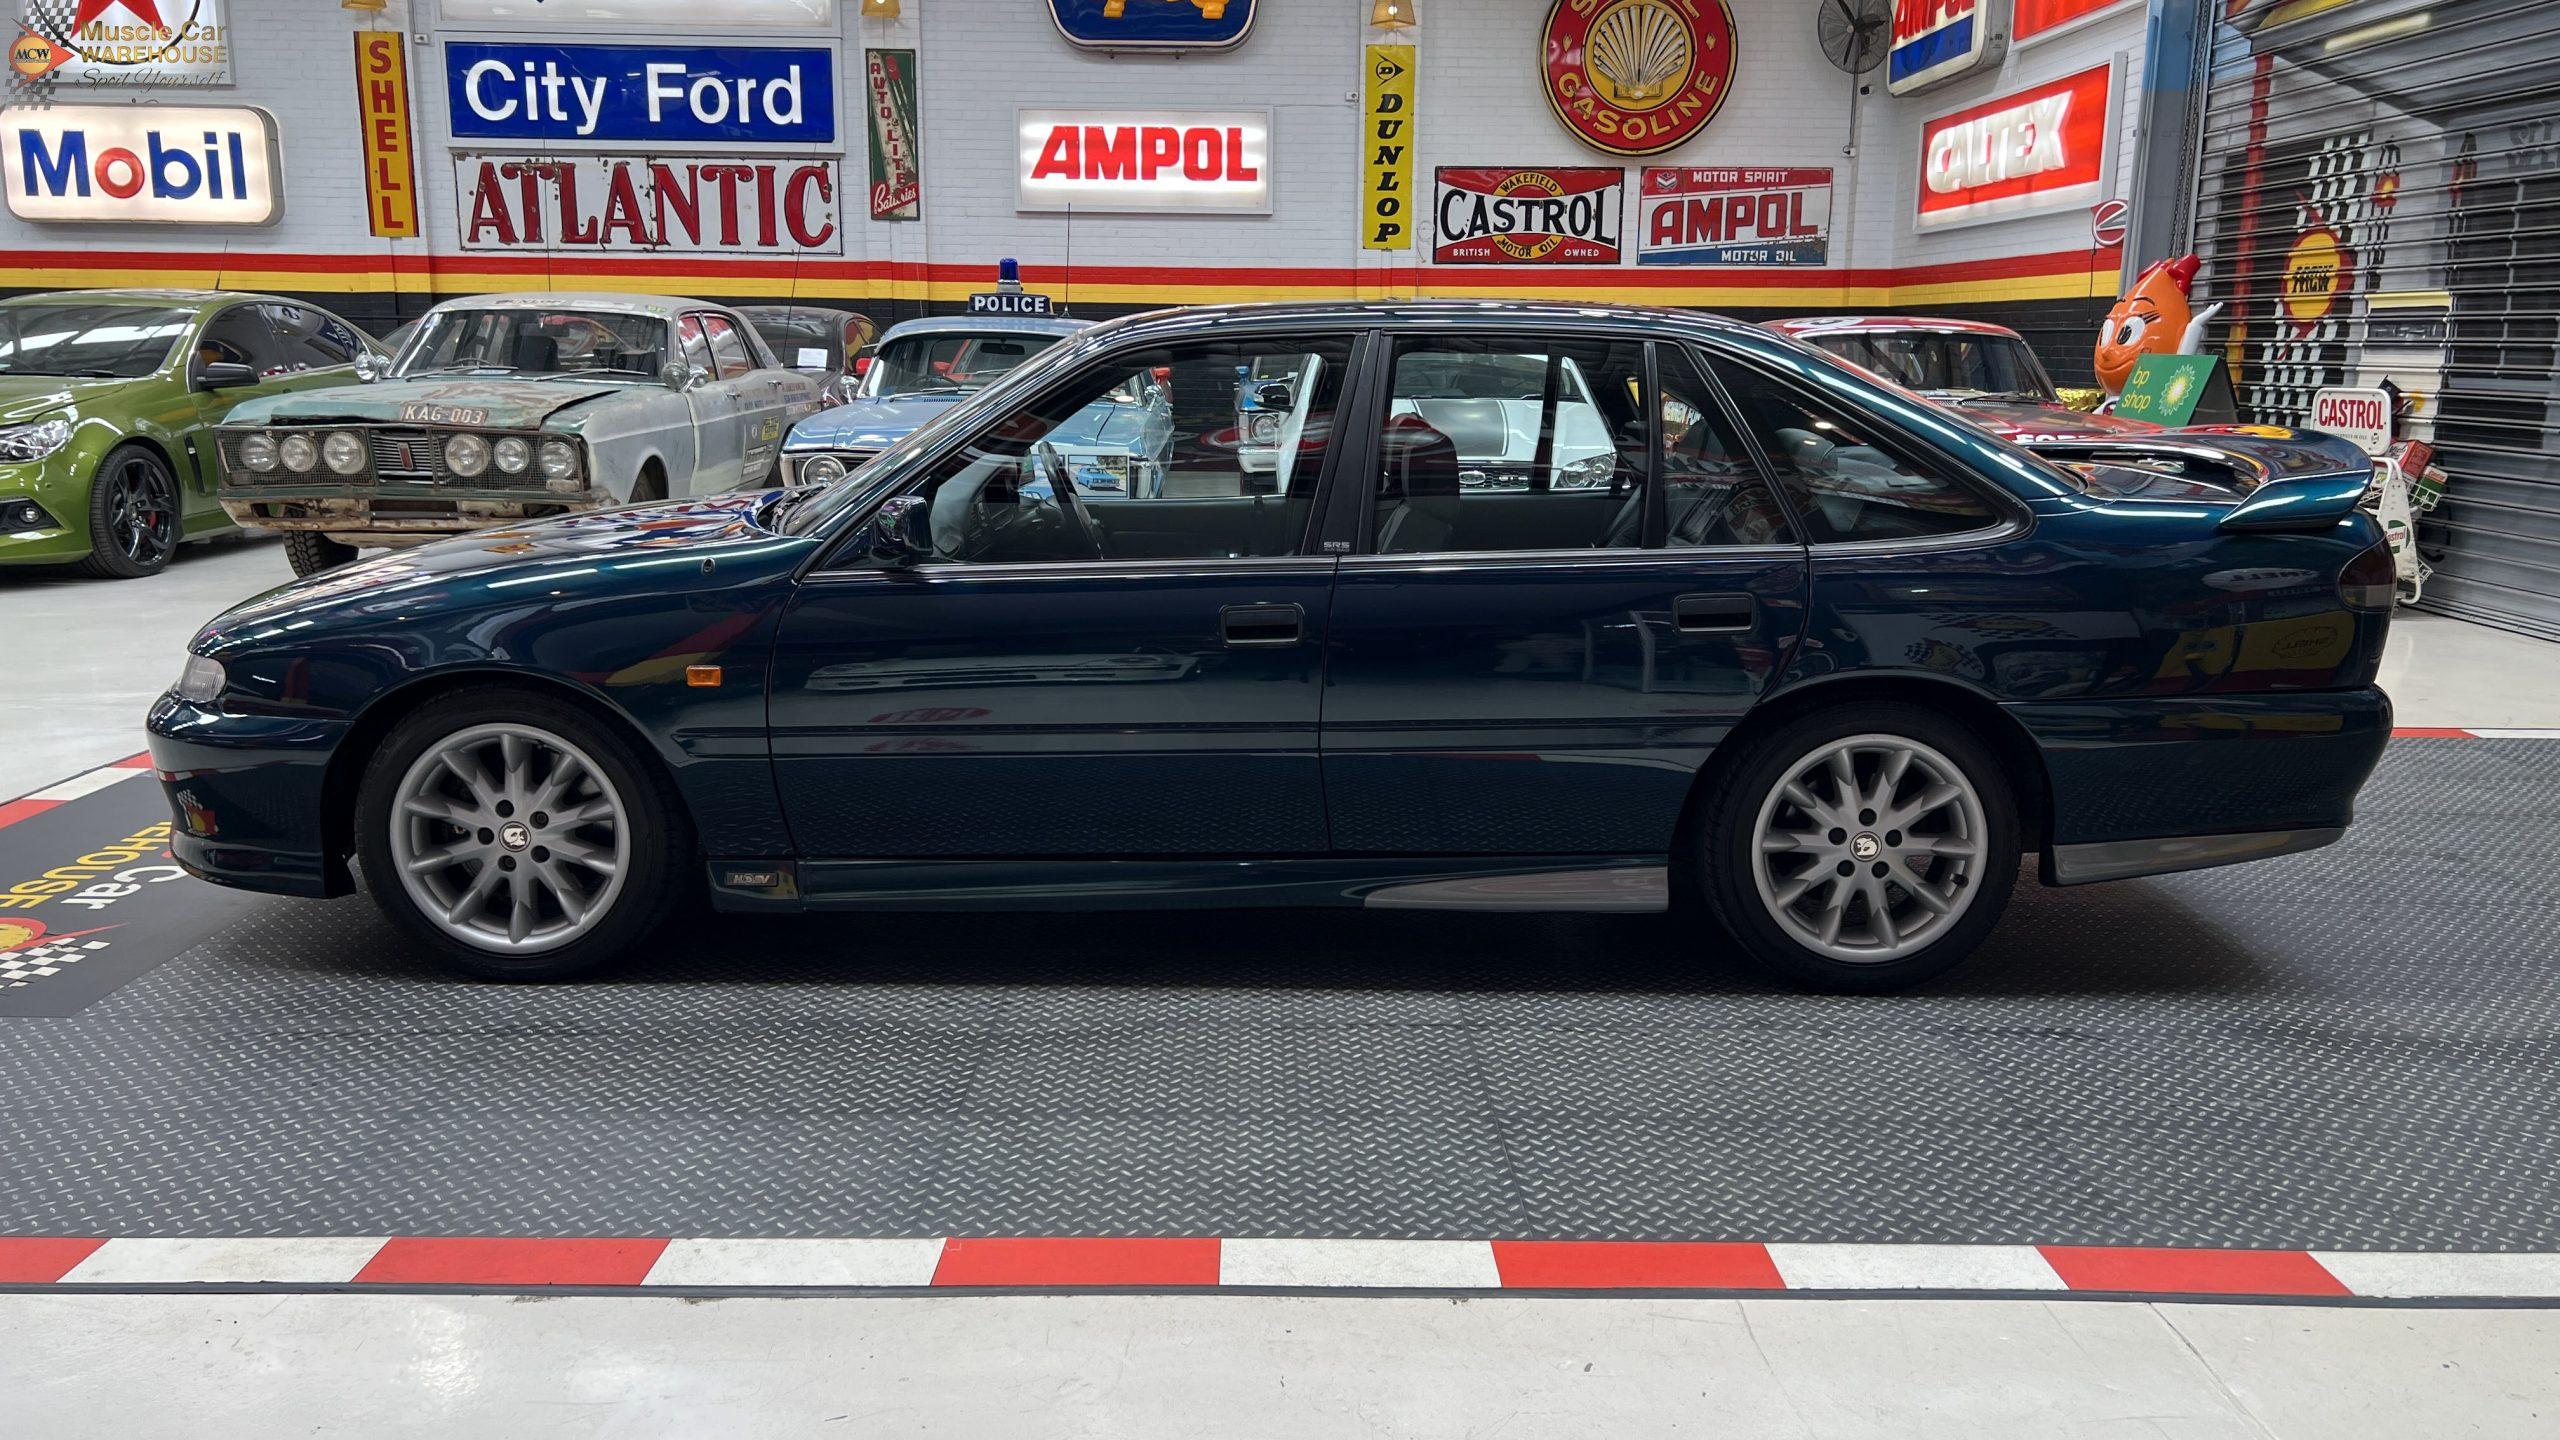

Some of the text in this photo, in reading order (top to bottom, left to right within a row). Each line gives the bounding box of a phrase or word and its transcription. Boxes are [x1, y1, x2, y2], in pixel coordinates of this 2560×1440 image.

[464, 59, 803, 136] City Ford
[1558, 69, 1719, 141] GASOLINE
[369, 40, 405, 229] SHELL
[1030, 125, 1258, 182] AMPOL
[1926, 89, 2073, 194] CALTEX
[18, 127, 248, 200] Mobil
[1373, 93, 1405, 242] DUNLOP
[1500, 172, 1558, 194] WAKEFIELD
[1693, 171, 1789, 183] MOTOR SPIRIT
[467, 160, 834, 248] ATLANTIC
[1440, 187, 1617, 247] CASTROL
[1650, 191, 1819, 247] AMPOL
[1452, 248, 1600, 257] BRITISH OWNED
[1500, 237, 1559, 258] MOTOR OIL
[1721, 250, 1797, 262] MOTOR OIL
[974, 295, 1046, 313] POLICE
[2121, 390, 2151, 413] shop
[2132, 365, 2151, 389] bp
[2319, 398, 2384, 430] CASTROL
[61, 866, 189, 910] Car
